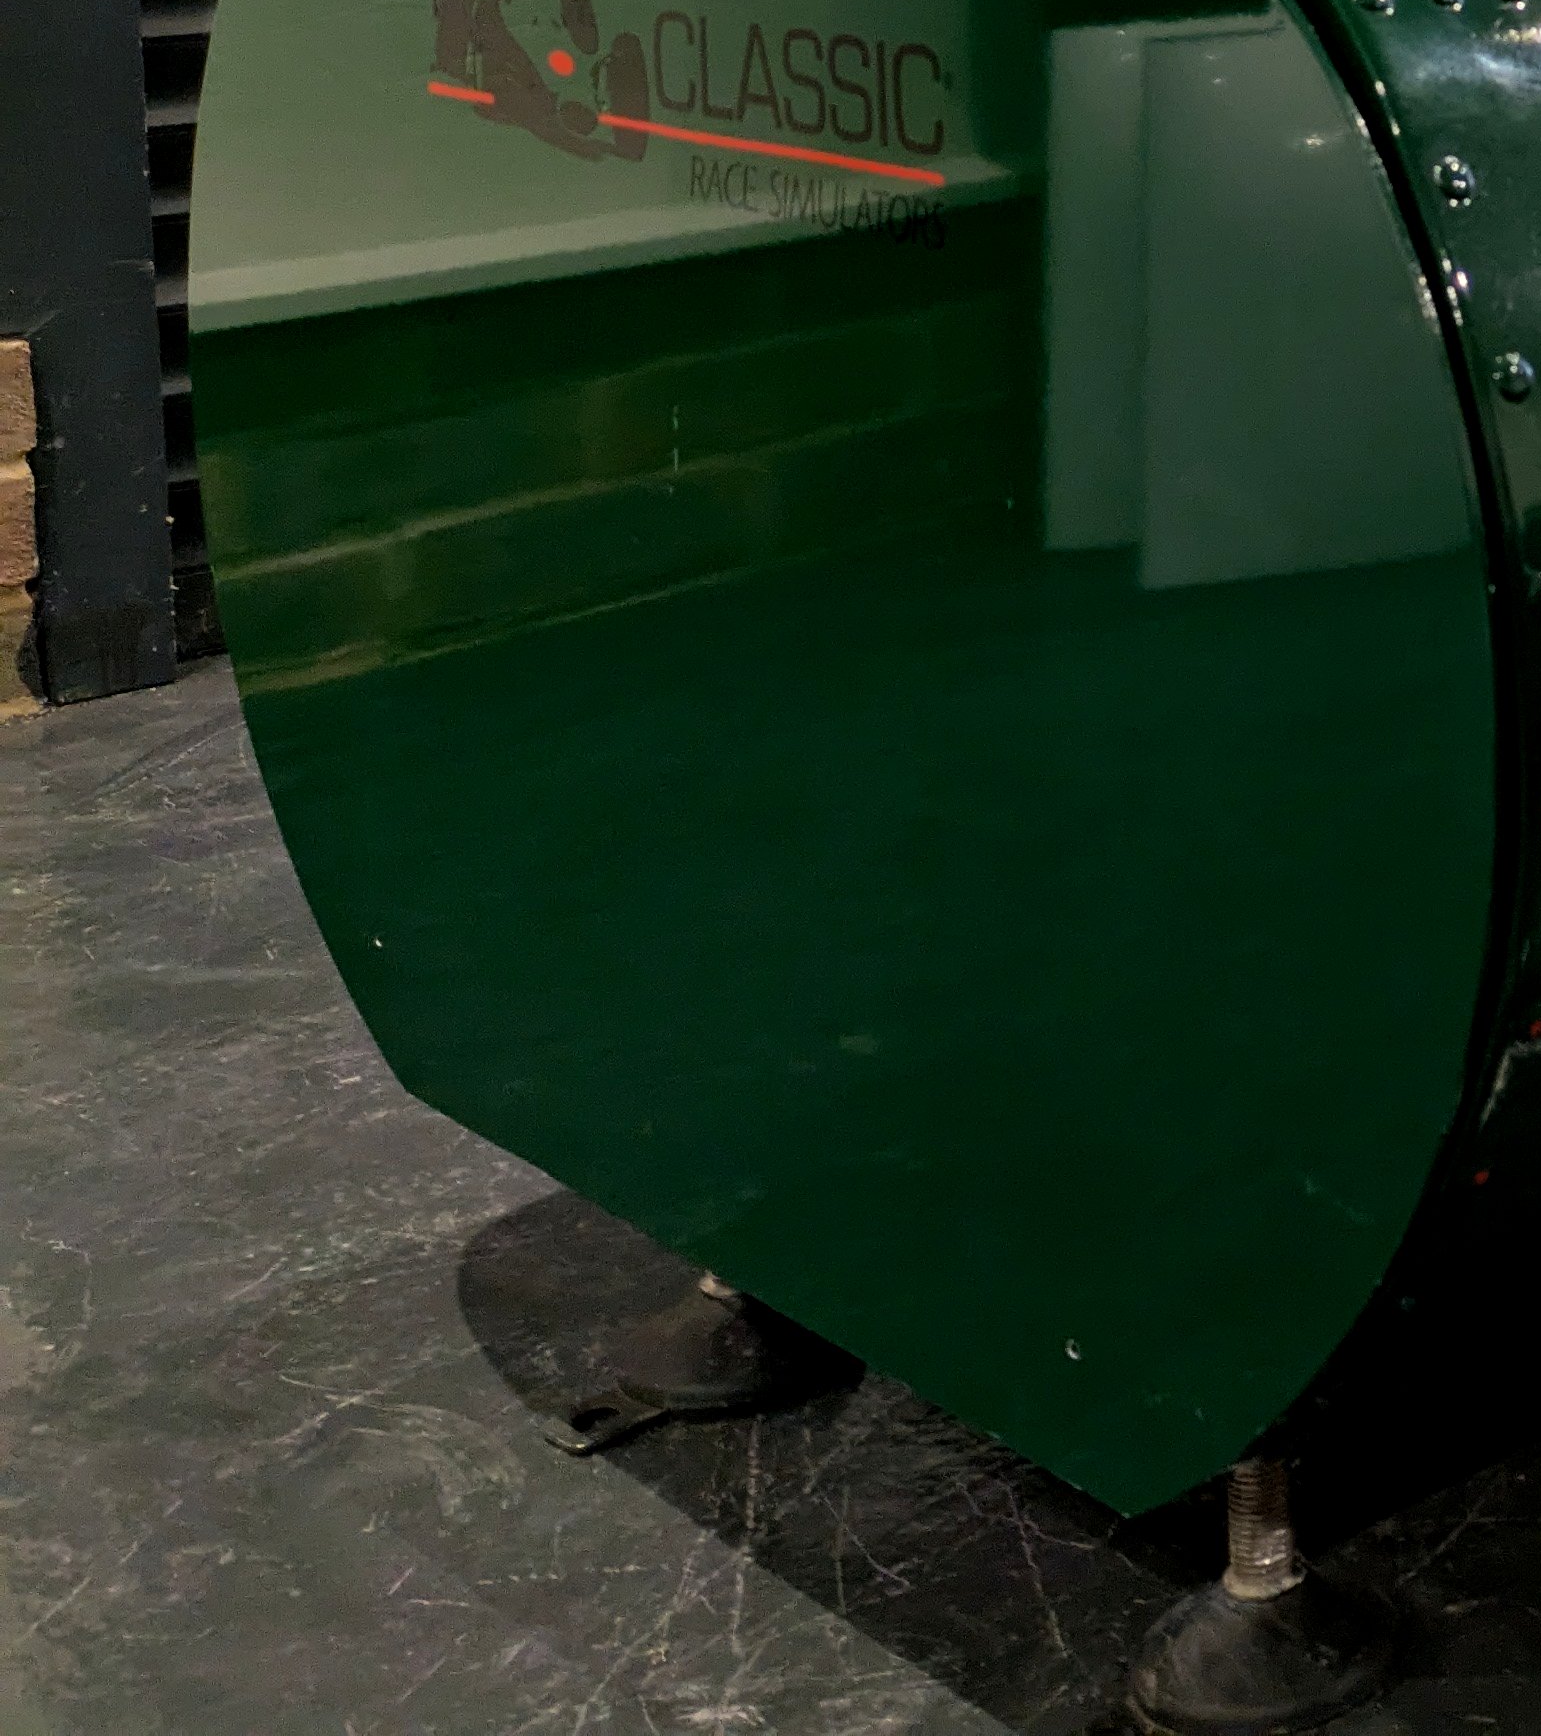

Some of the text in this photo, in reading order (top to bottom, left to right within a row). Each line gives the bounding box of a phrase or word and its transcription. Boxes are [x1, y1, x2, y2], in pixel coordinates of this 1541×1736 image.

[652, 10, 945, 155] CLASSIC
[690, 154, 947, 250] RACE SIMULATORS
